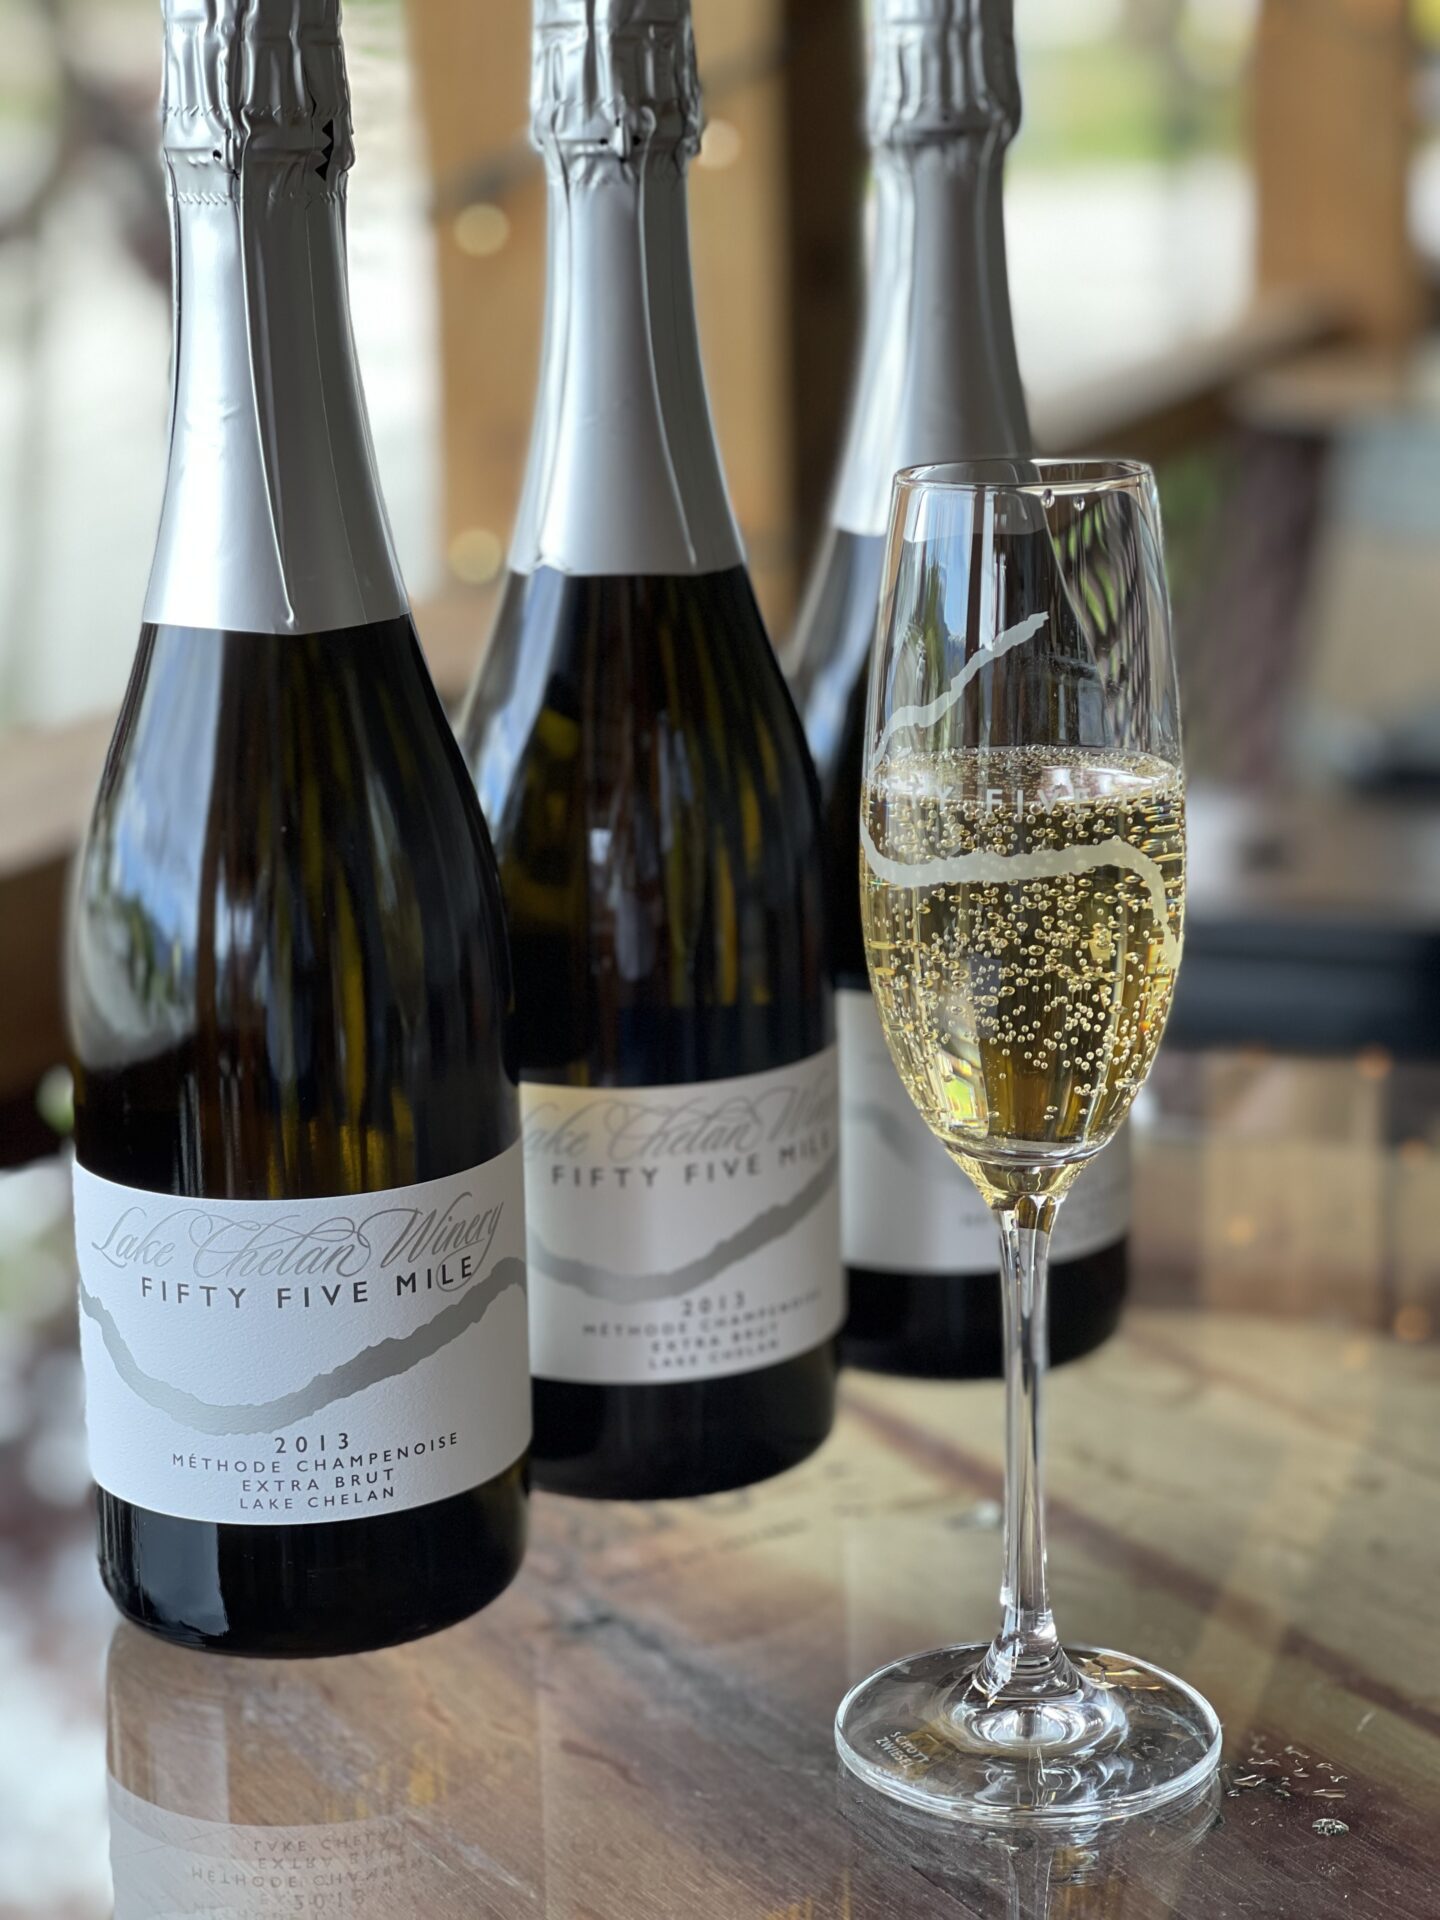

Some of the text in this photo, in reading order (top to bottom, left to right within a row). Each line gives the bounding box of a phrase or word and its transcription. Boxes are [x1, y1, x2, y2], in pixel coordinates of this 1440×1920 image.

[986, 788, 1092, 815] FIVE
[603, 1096, 762, 1163] Chelan
[552, 1164, 659, 1188] FIFTY
[684, 1153, 762, 1185] FIVE
[92, 1192, 504, 1292] Lake Chelan Winery
[141, 1255, 473, 1309] FIFTY FIVE MILE
[172, 1432, 458, 1473] MÉTHODE CHAMPENOISE
[274, 1432, 349, 1454] 2013
[243, 1468, 394, 1492] EXTRA BRUT
[240, 1486, 394, 1509] LAKE CHELAN
[876, 1736, 914, 1768] ZWIESEL
[890, 1731, 929, 1763] SCHOTT
